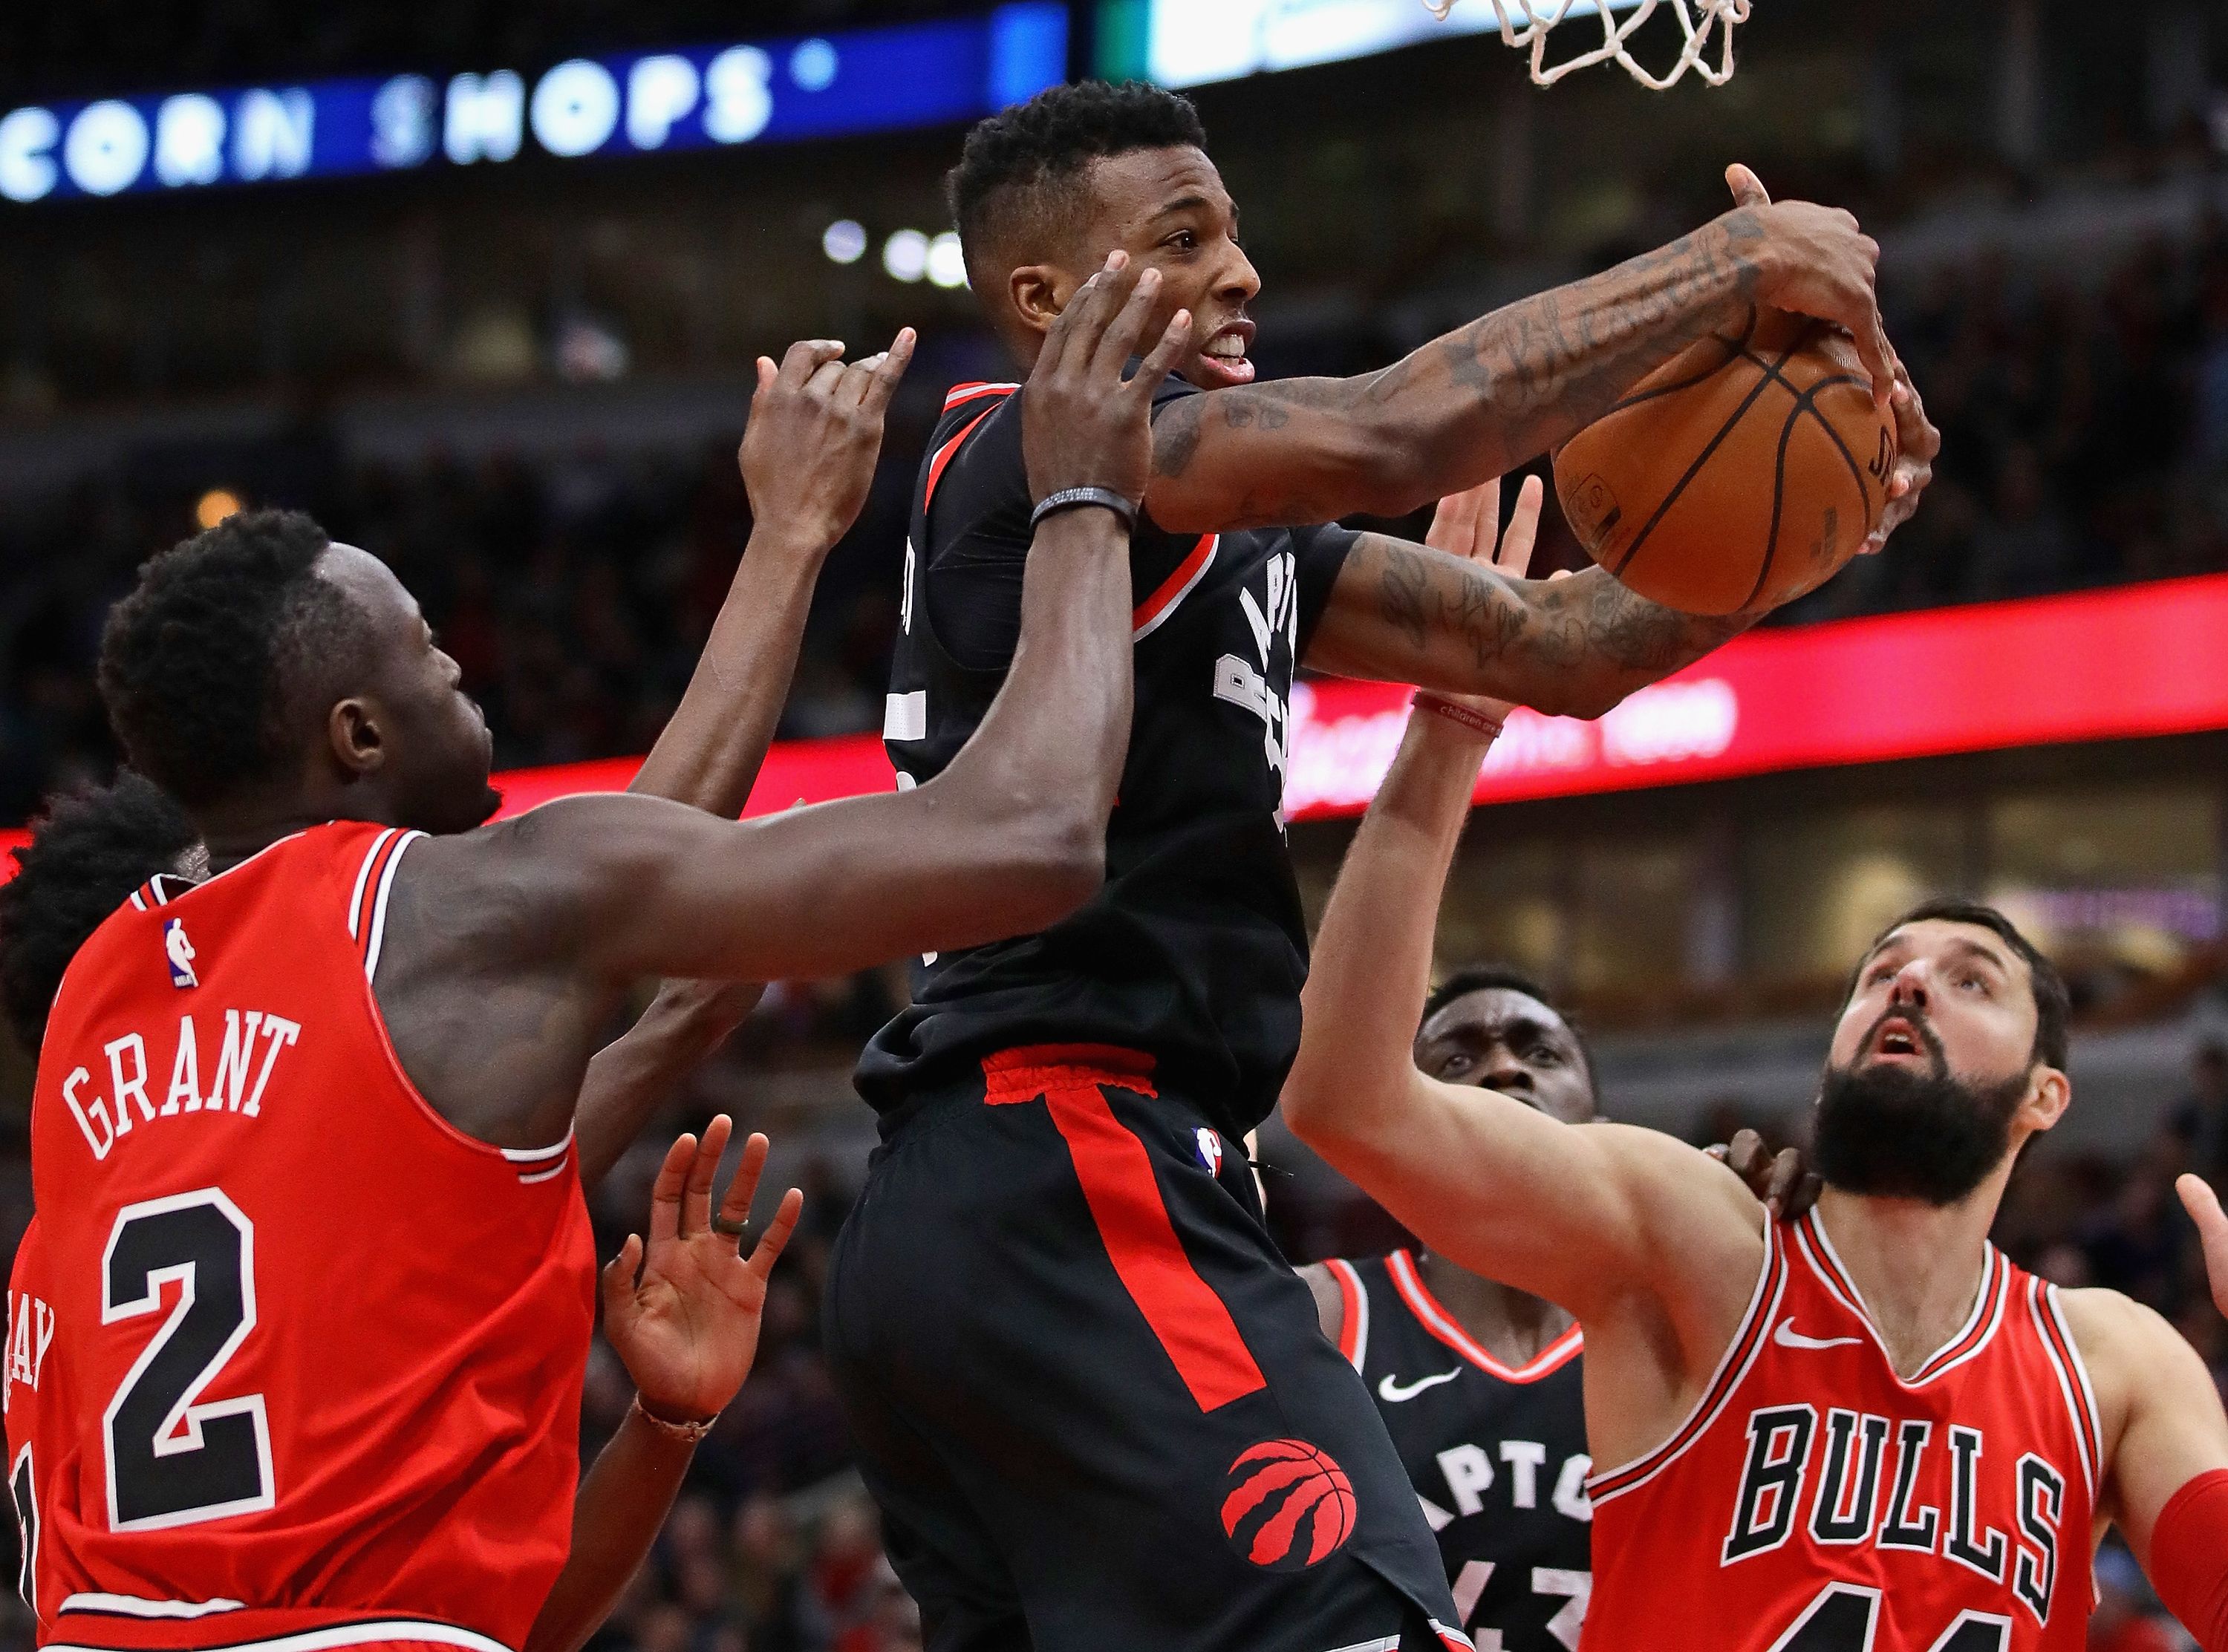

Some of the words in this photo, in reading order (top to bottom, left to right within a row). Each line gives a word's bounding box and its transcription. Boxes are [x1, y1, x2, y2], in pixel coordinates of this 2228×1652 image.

[0, 92, 315, 203] CORN
[368, 44, 773, 168] SHOPS
[62, 1008, 302, 1161] GRANT
[4, 1289, 56, 1414] AY
[101, 1186, 276, 1534] 2
[1719, 1402, 2066, 1630] BULLS
